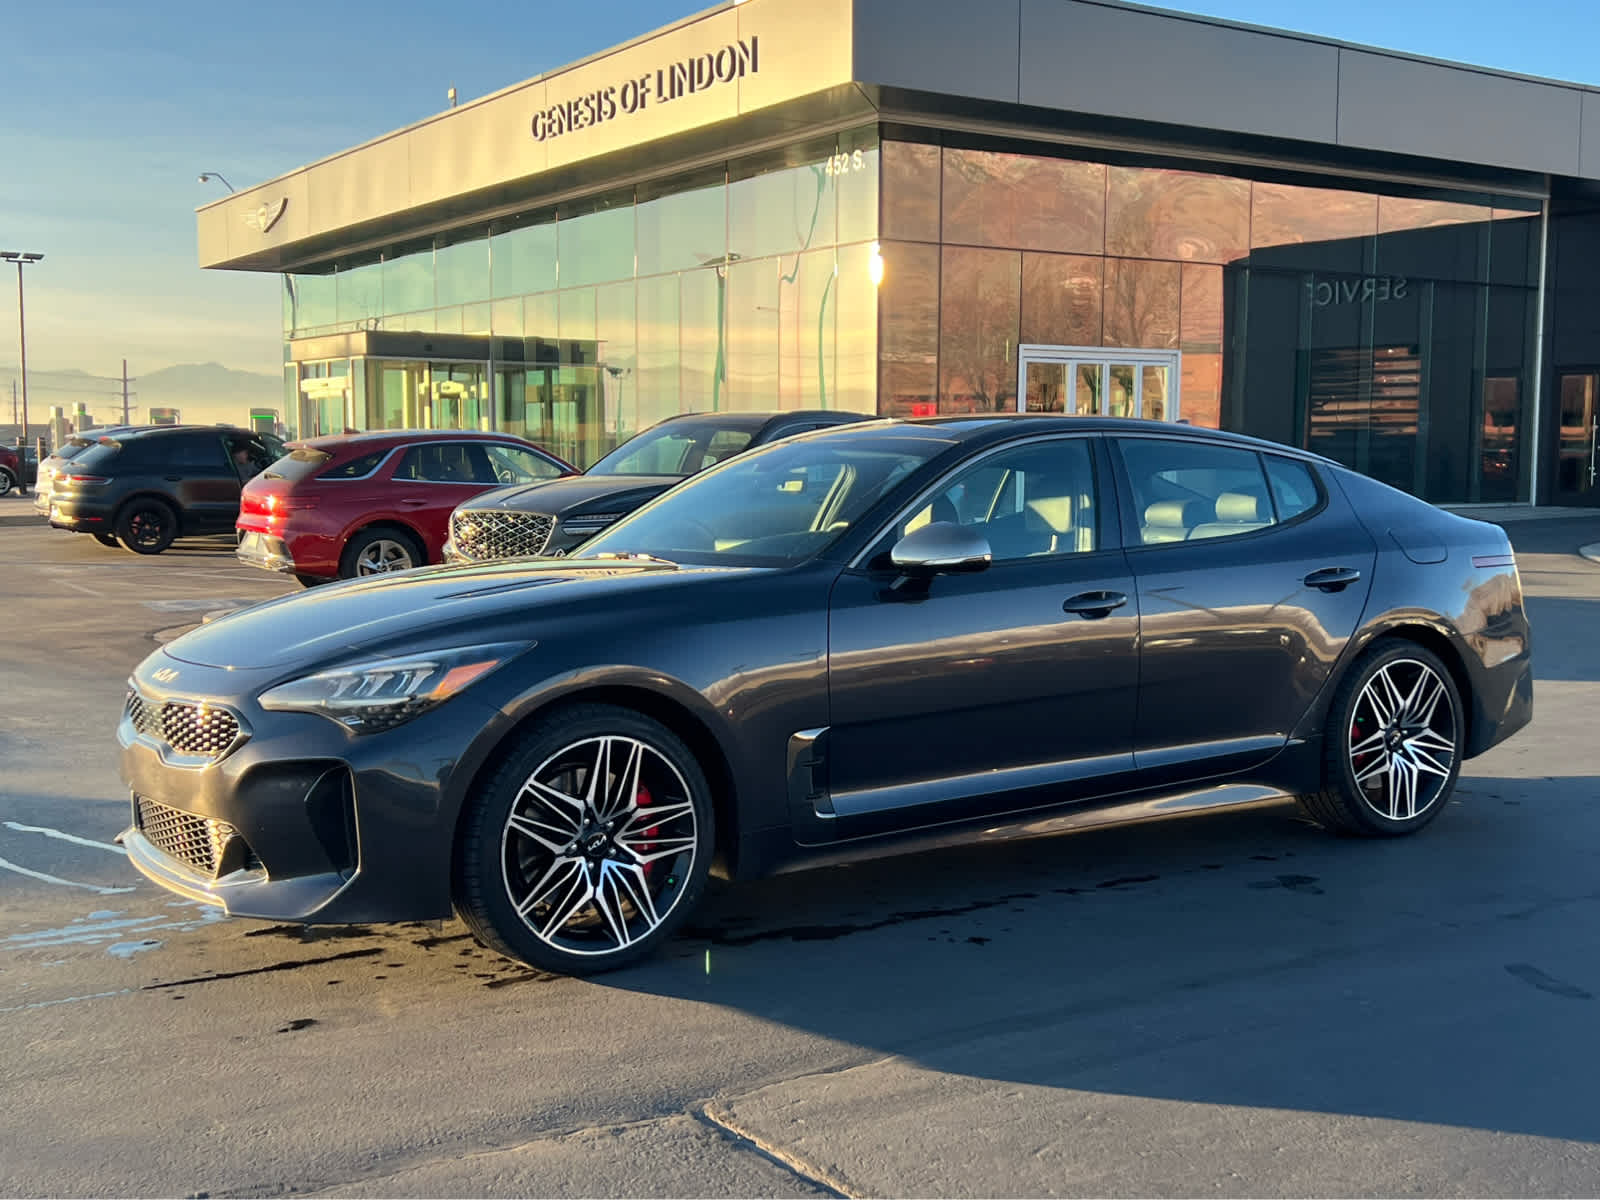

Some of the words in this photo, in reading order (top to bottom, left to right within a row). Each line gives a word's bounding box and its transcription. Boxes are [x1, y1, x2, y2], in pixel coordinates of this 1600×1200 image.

[531, 86, 616, 142] GENESIS
[620, 73, 651, 114] OF
[656, 35, 759, 104] LINDON
[825, 152, 849, 176] 452
[853, 149, 866, 171] S.
